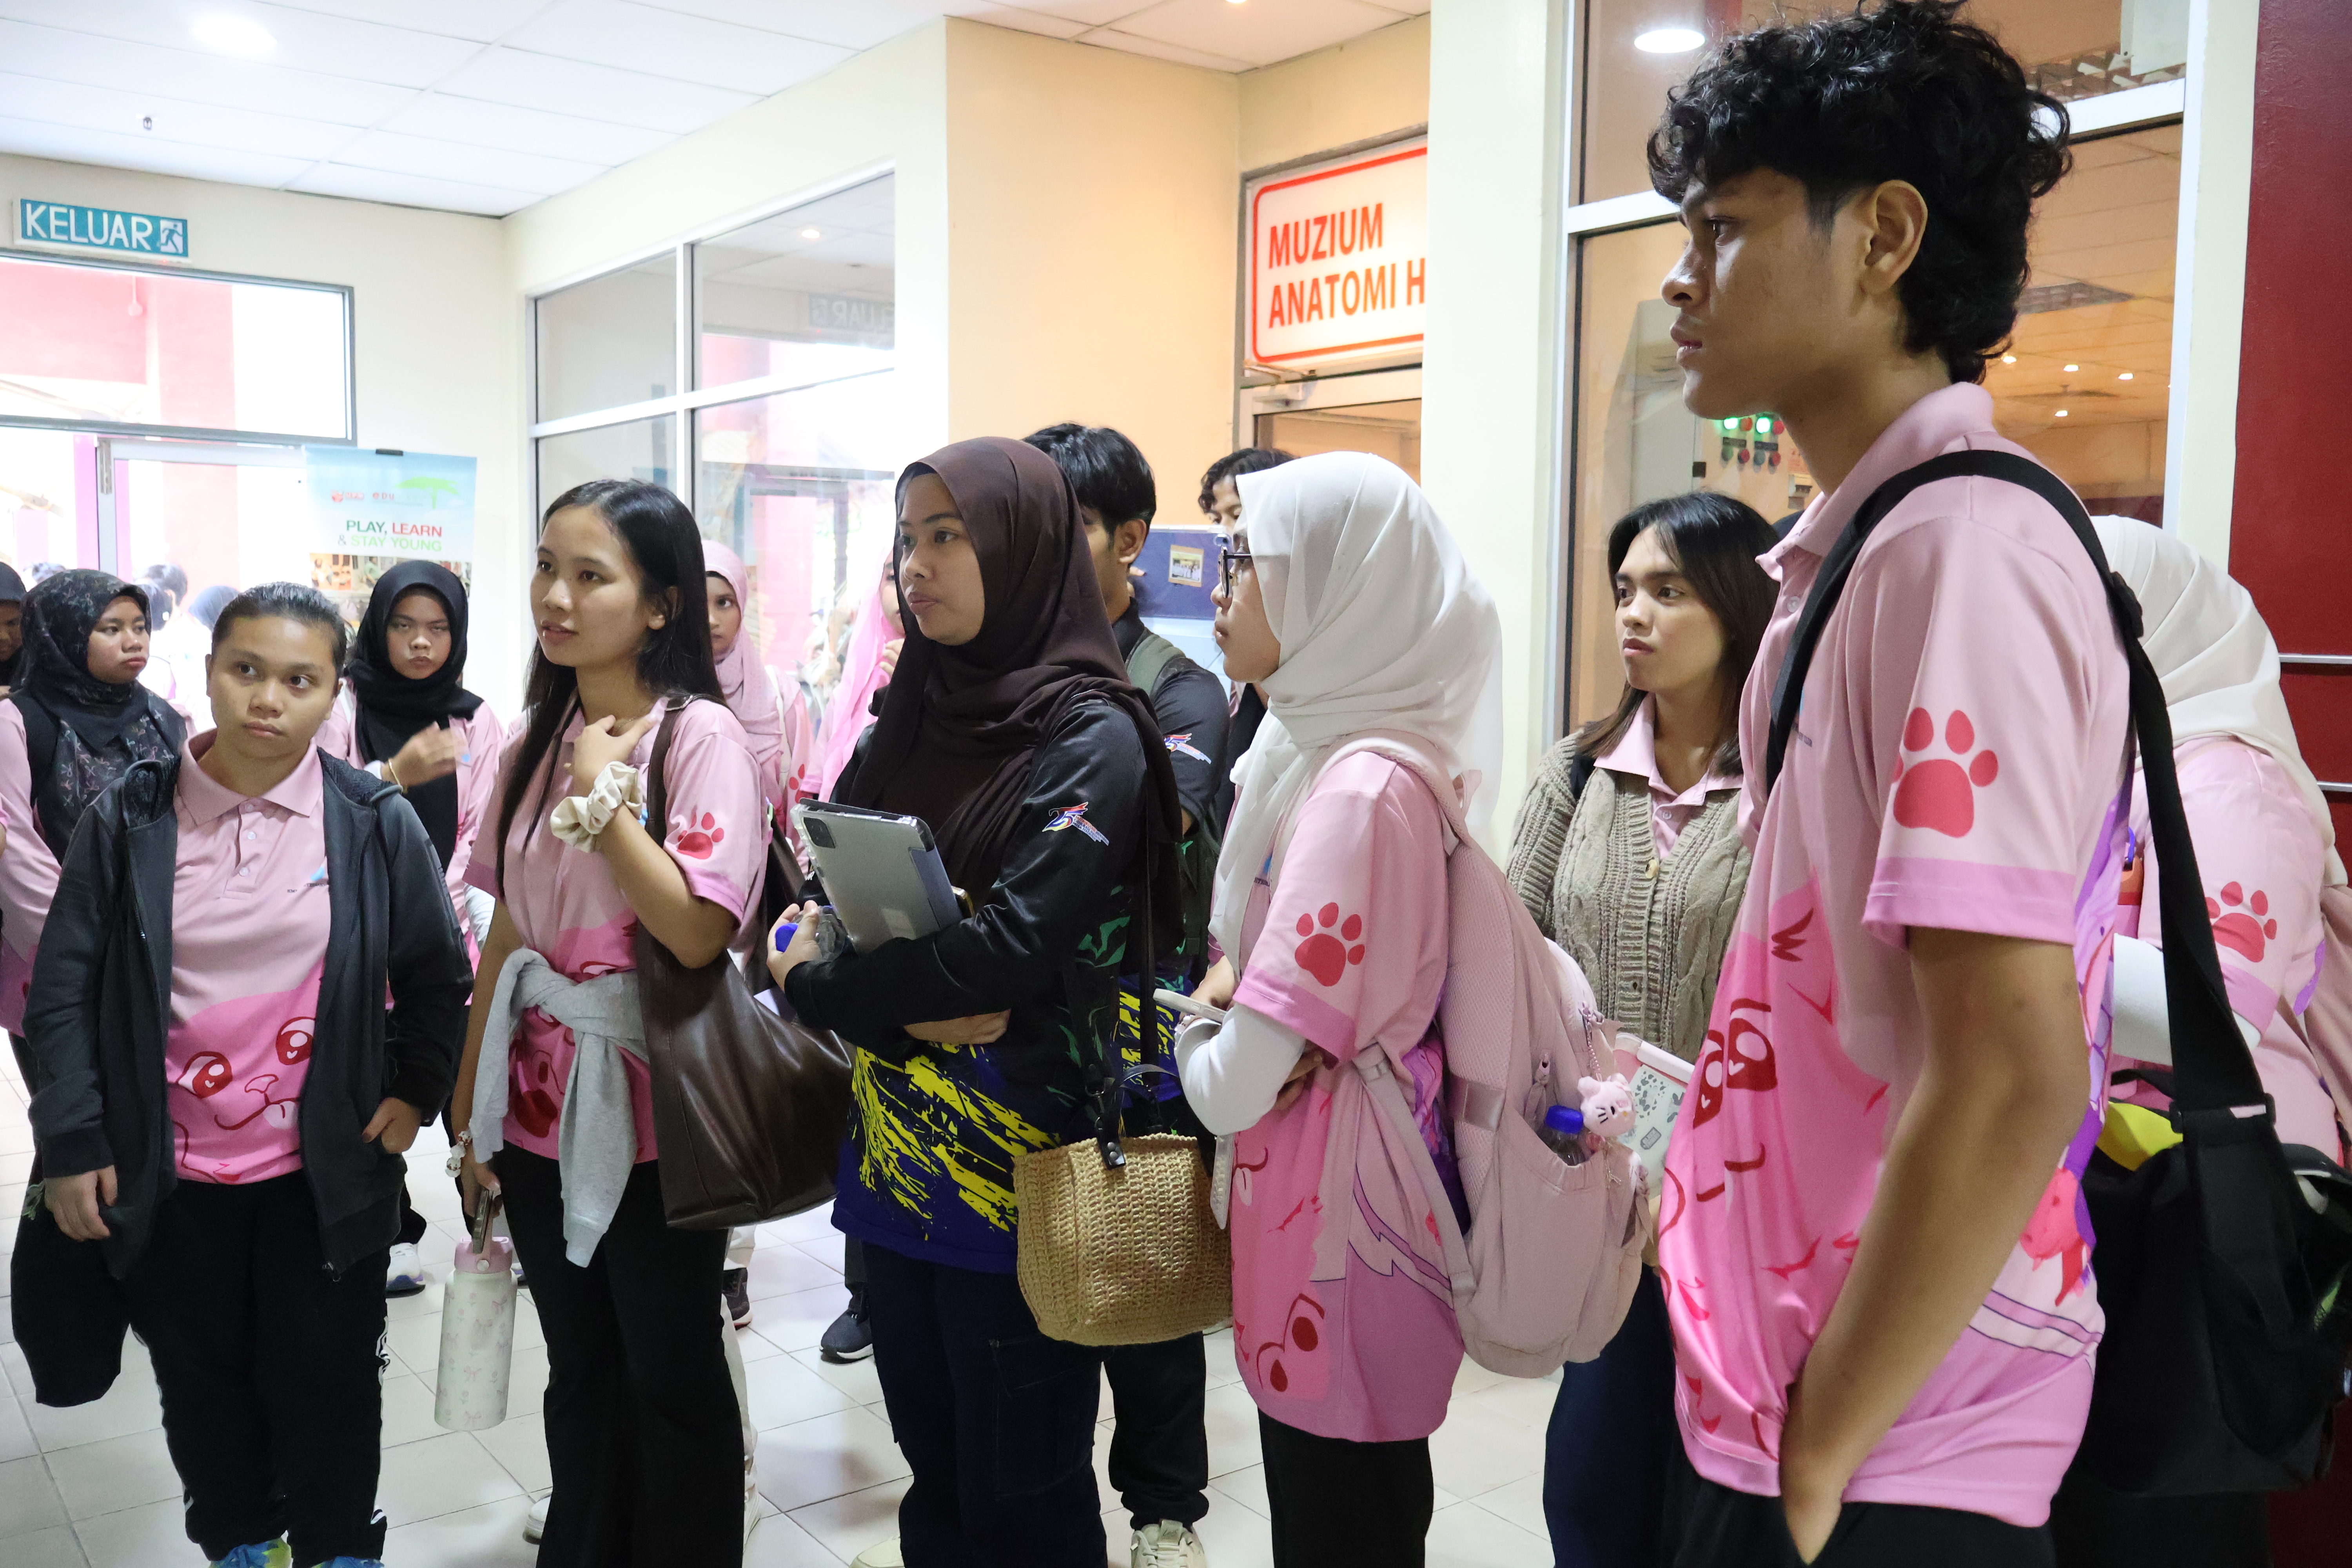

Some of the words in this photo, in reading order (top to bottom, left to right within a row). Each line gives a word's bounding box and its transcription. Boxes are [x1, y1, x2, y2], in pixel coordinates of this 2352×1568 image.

[26, 203, 153, 250] KELUAR
[1269, 203, 1383, 269] MUZIUM
[1269, 263, 1396, 329] ANATOMI
[1406, 258, 1425, 306] H
[338, 534, 347, 546] &
[351, 535, 387, 547] STAY
[390, 537, 443, 552] YOUNG
[346, 520, 387, 535] PLAY,
[392, 522, 442, 537] LEARN
